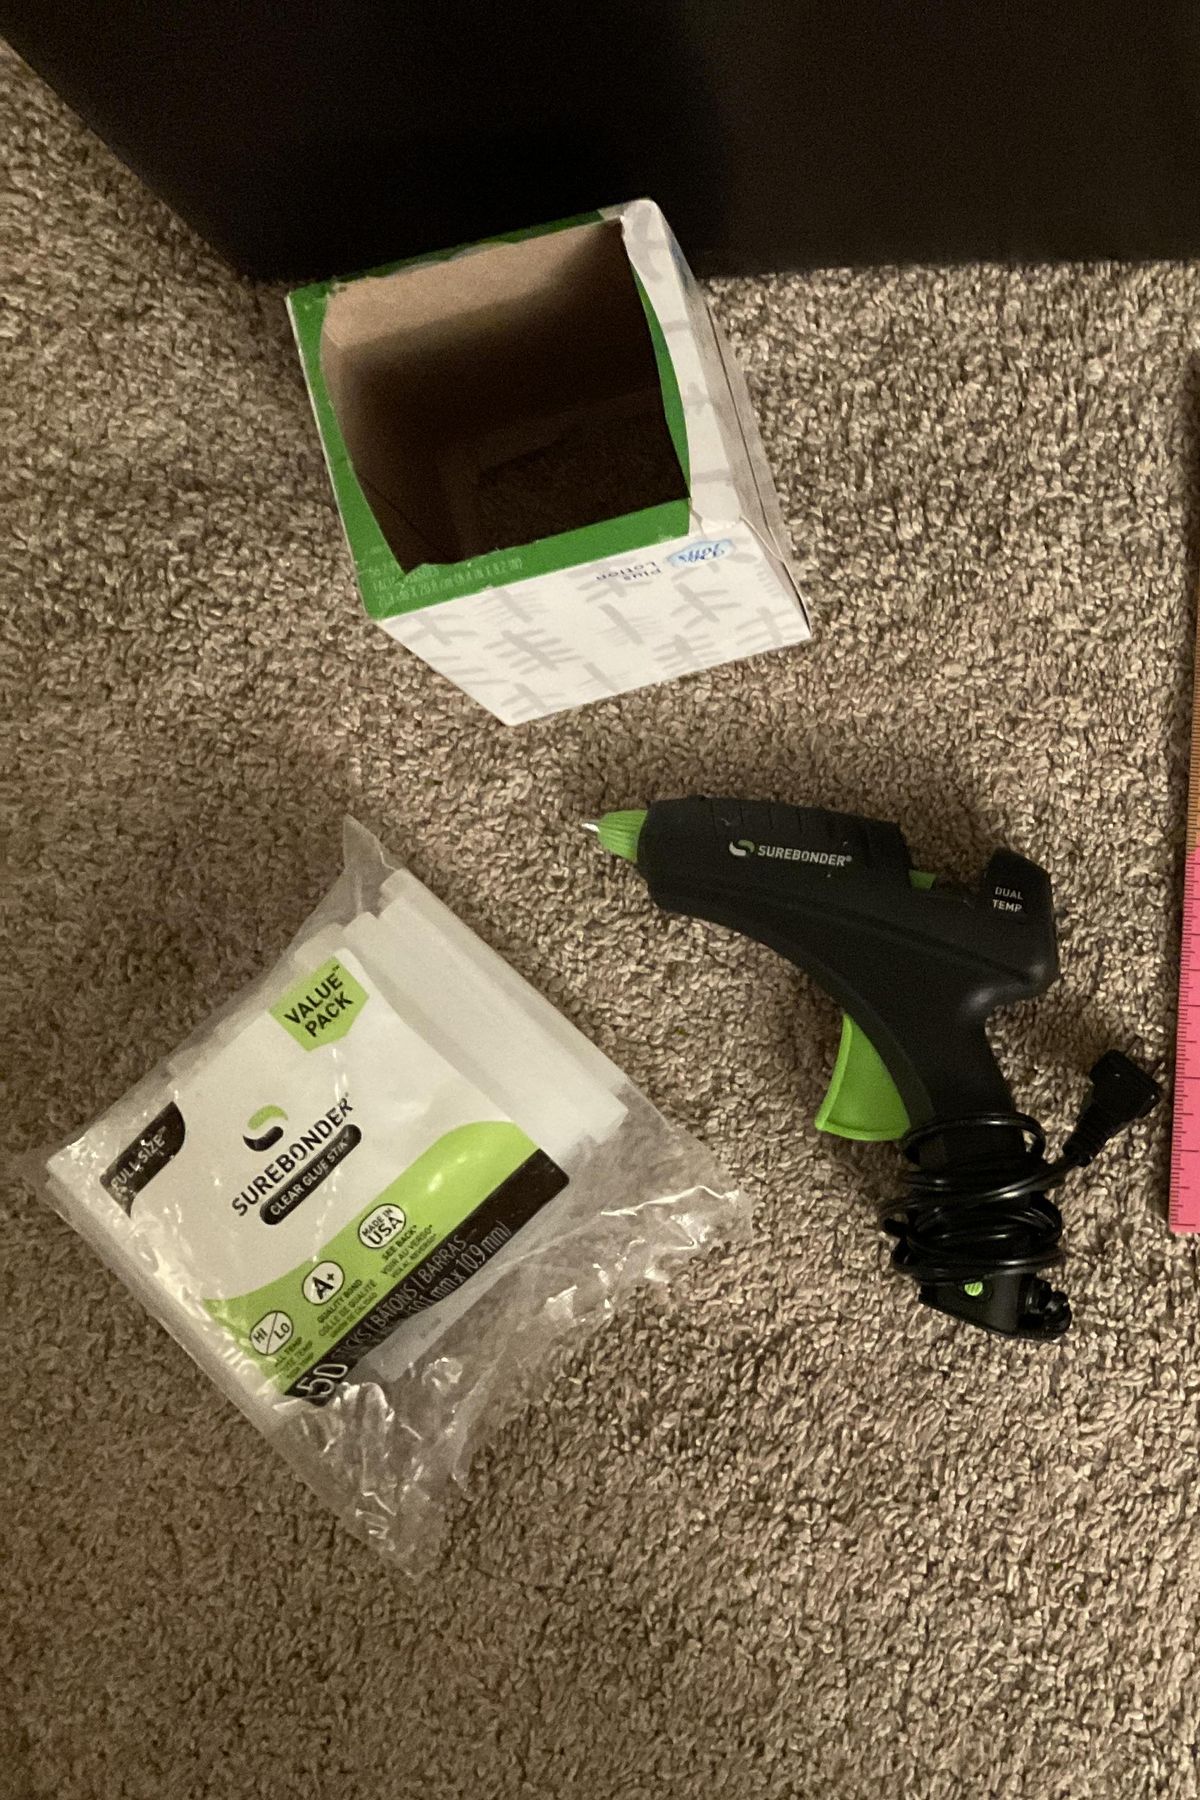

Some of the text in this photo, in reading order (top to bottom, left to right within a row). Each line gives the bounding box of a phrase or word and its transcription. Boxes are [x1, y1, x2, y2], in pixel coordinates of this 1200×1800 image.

[595, 560, 657, 581] Lotion
[623, 567, 662, 582] Plus
[992, 898, 1023, 913] TEMP
[995, 886, 1024, 900] DUAL
[302, 990, 353, 1038] PACK
[109, 1159, 141, 1191] FULL
[268, 1183, 305, 1217] CLEAR
[301, 1159, 329, 1187] GLUE
[361, 1207, 392, 1237] MADE IN
[367, 1212, 403, 1246] USA
[381, 1245, 397, 1261] SEE
[453, 1242, 488, 1276] 10.9
[305, 1265, 340, 1300] A+
[451, 1268, 466, 1283] x
[296, 1363, 348, 1398] 50
[417, 1233, 468, 1284] BARRAS
[315, 1277, 363, 1324] QUALITY BOND
[251, 1326, 268, 1343] HI
[273, 1321, 291, 1339] LO
